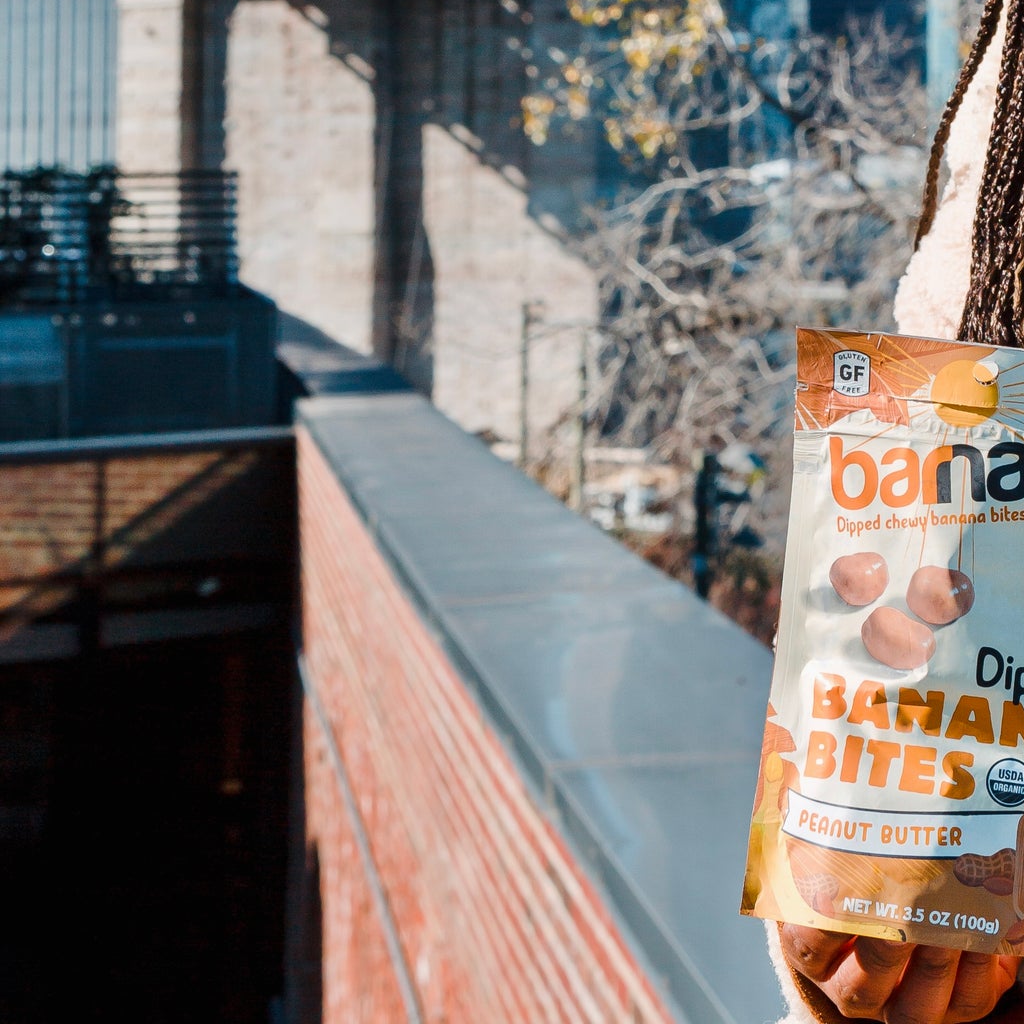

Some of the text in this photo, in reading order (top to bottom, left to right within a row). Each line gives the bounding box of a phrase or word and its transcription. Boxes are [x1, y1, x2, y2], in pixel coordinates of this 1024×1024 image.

[838, 352, 867, 363] GLUTEN
[840, 364, 865, 381] GF
[841, 385, 861, 394] FREE
[837, 515, 881, 536] Dipped
[885, 514, 927, 533] chewy
[931, 509, 986, 525] banana
[803, 730, 976, 800] BITES
[998, 768, 1024, 782] USDA
[799, 809, 962, 846] PEANUT BUTTER
[843, 896, 1000, 935] NET WT. 3.5 OZ (100g)
